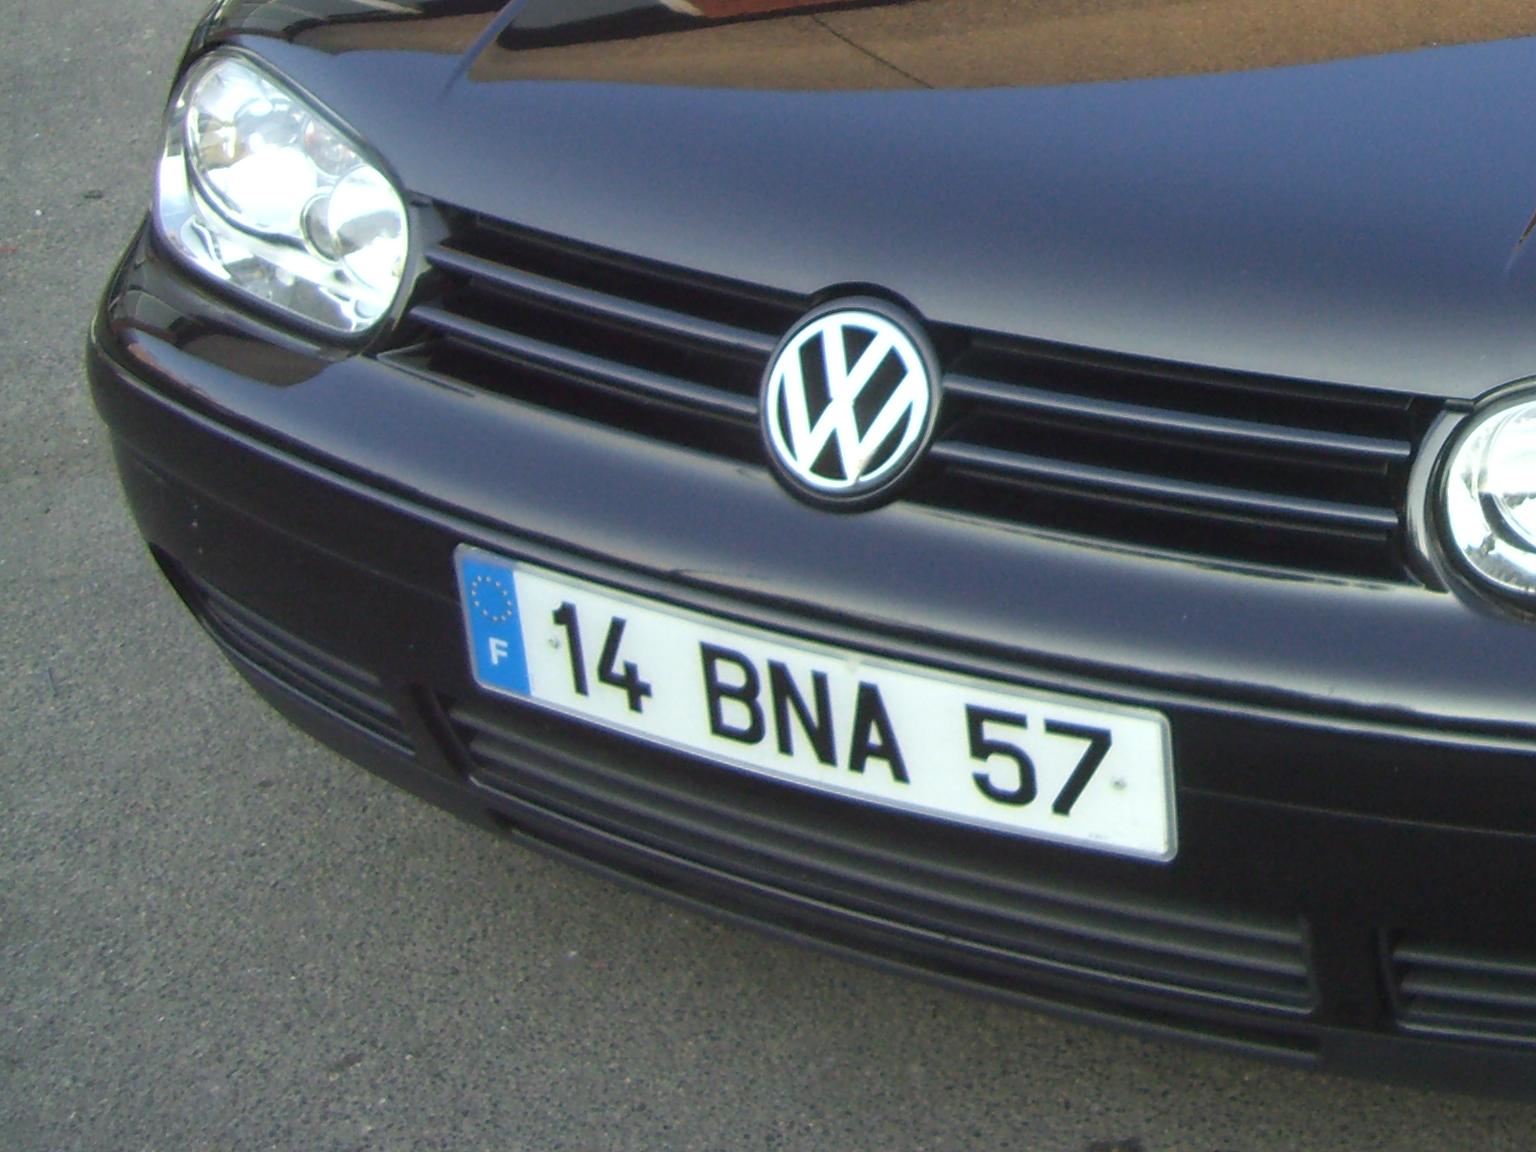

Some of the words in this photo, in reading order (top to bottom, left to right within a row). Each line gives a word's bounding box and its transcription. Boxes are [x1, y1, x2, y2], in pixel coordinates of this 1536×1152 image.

[766, 311, 930, 489] VW
[488, 637, 509, 666] F
[551, 601, 653, 714] 14
[698, 639, 911, 786] BNA
[964, 703, 1114, 817] 57
